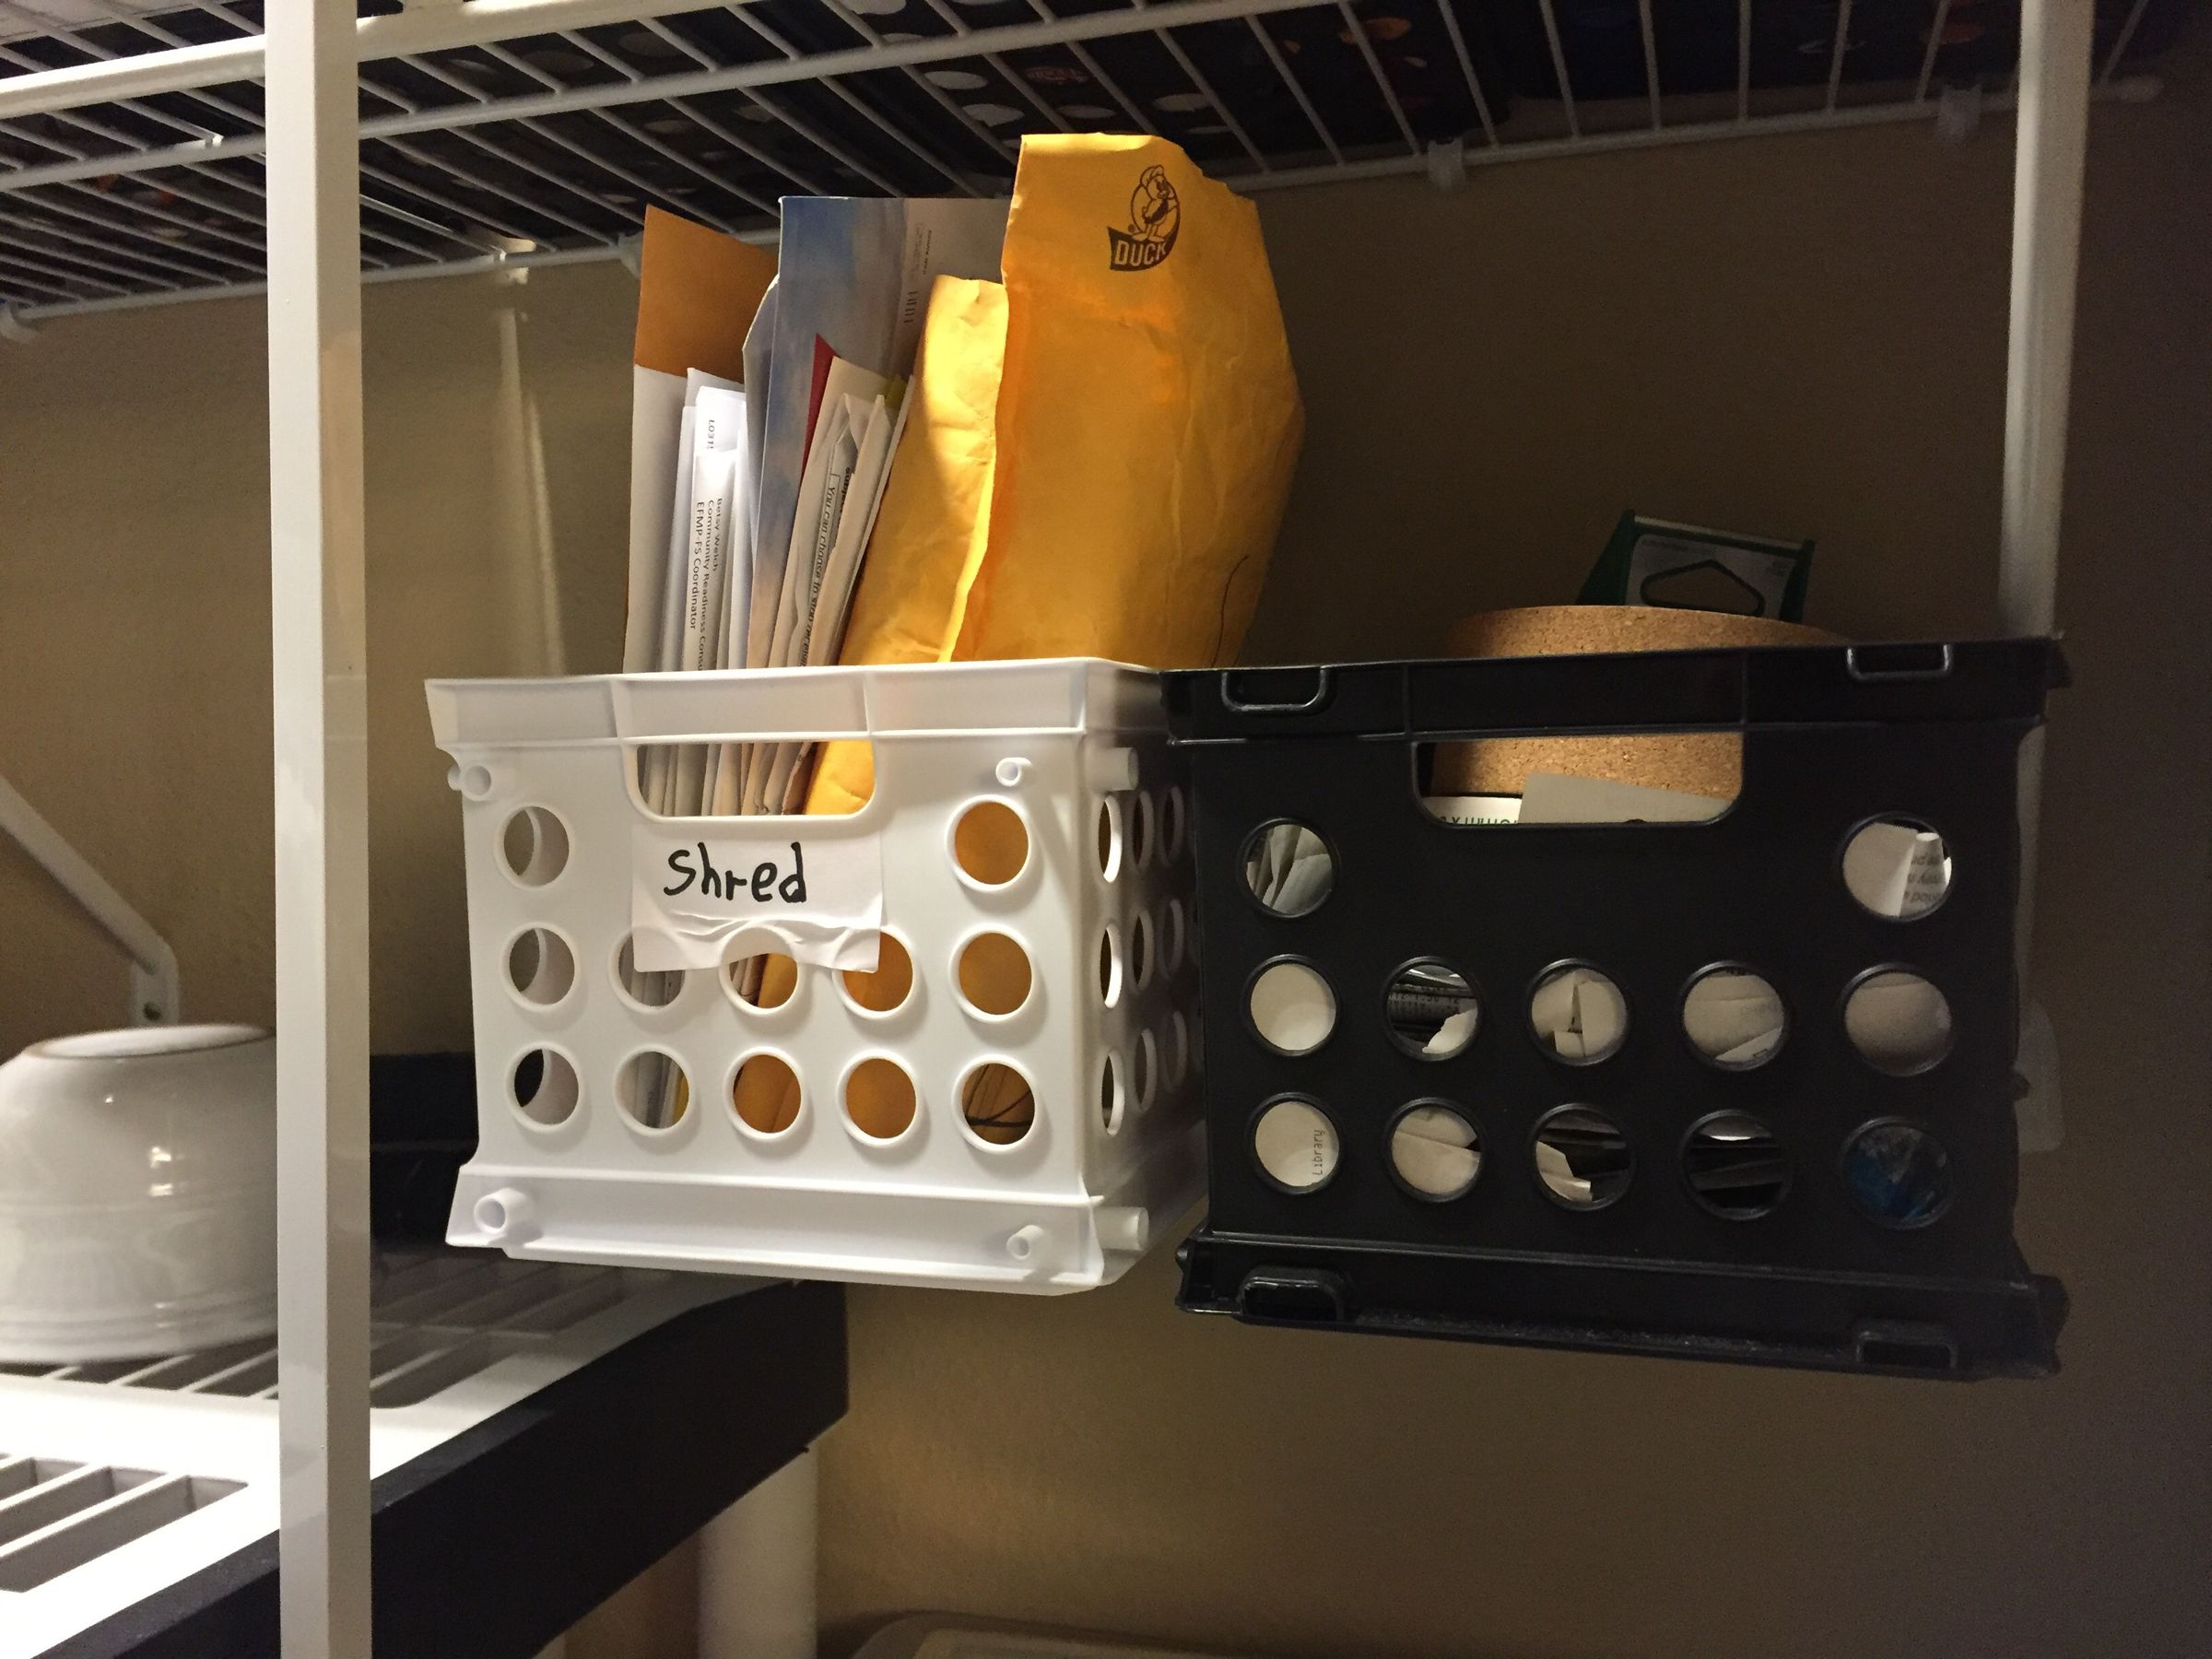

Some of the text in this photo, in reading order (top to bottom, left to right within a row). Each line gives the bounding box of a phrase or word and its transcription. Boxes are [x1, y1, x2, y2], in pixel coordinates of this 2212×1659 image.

[1113, 240, 1168, 267] DUCK
[826, 487, 836, 508] You
[703, 500, 714, 570] Community
[822, 512, 830, 534] can
[689, 501, 705, 629] EFMP-FS Coordinator
[712, 535, 721, 571] Welch
[815, 535, 828, 579] choose
[700, 573, 710, 633] Readiness
[664, 841, 806, 903] Shred
[1312, 1129, 1325, 1176] Library
